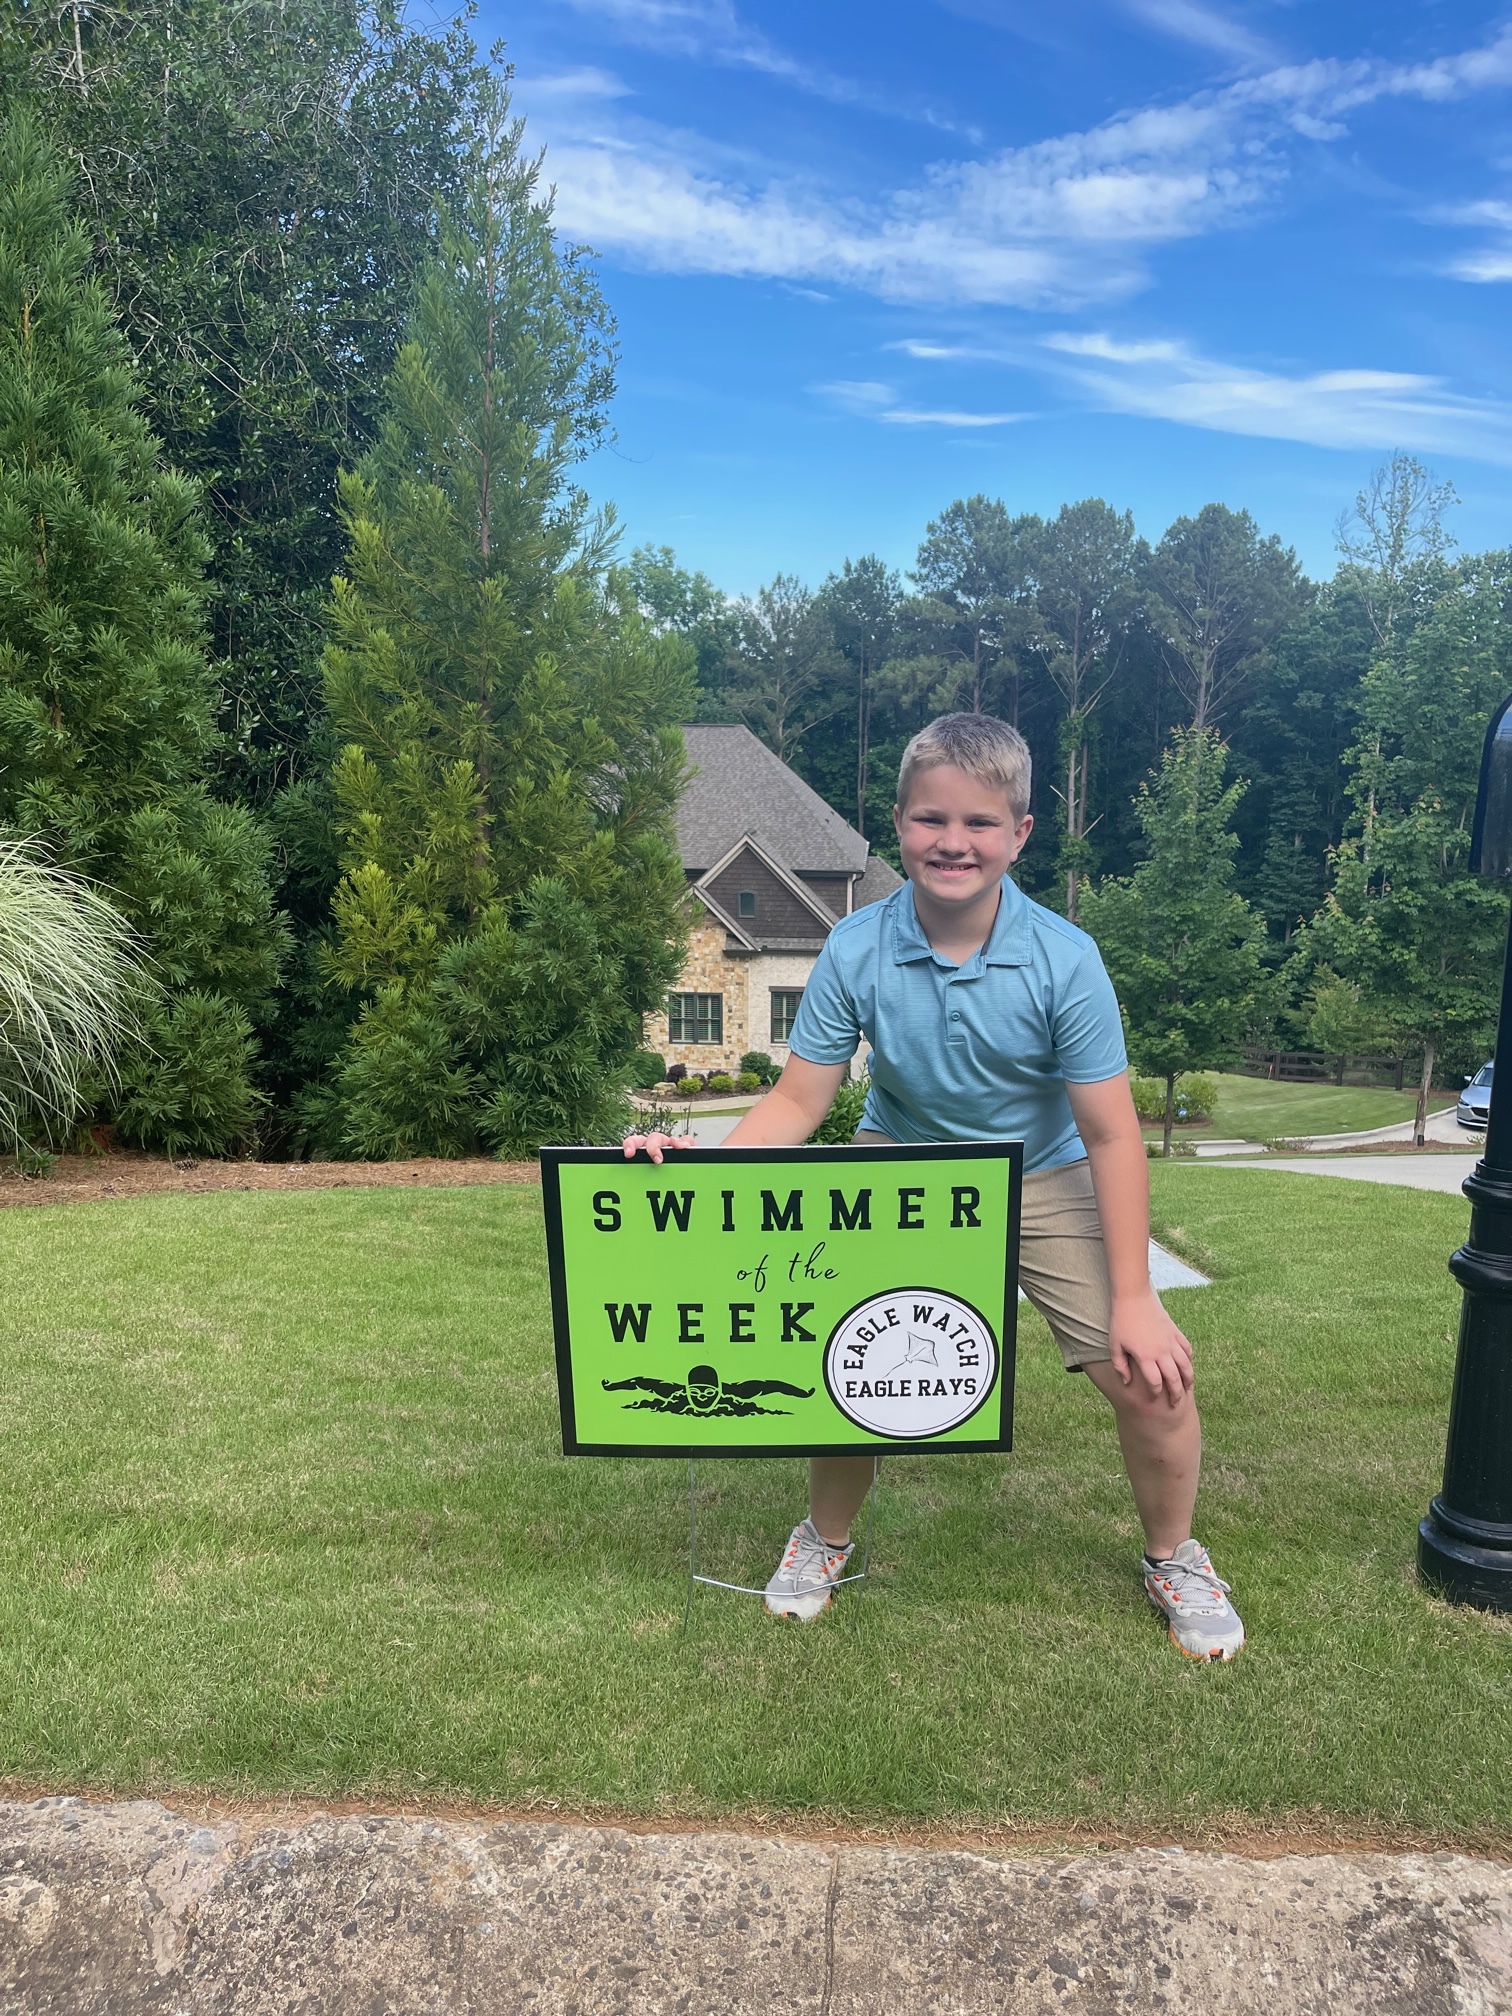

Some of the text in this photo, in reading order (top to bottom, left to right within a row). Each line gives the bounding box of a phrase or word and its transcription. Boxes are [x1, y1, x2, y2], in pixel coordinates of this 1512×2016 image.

[592, 1186, 982, 1232] SWIMMER
[736, 1241, 840, 1293] of the
[604, 1302, 817, 1343] WEEK
[843, 1304, 979, 1371] EAGLE WATCH
[845, 1378, 977, 1399] EAGLE RAYS
